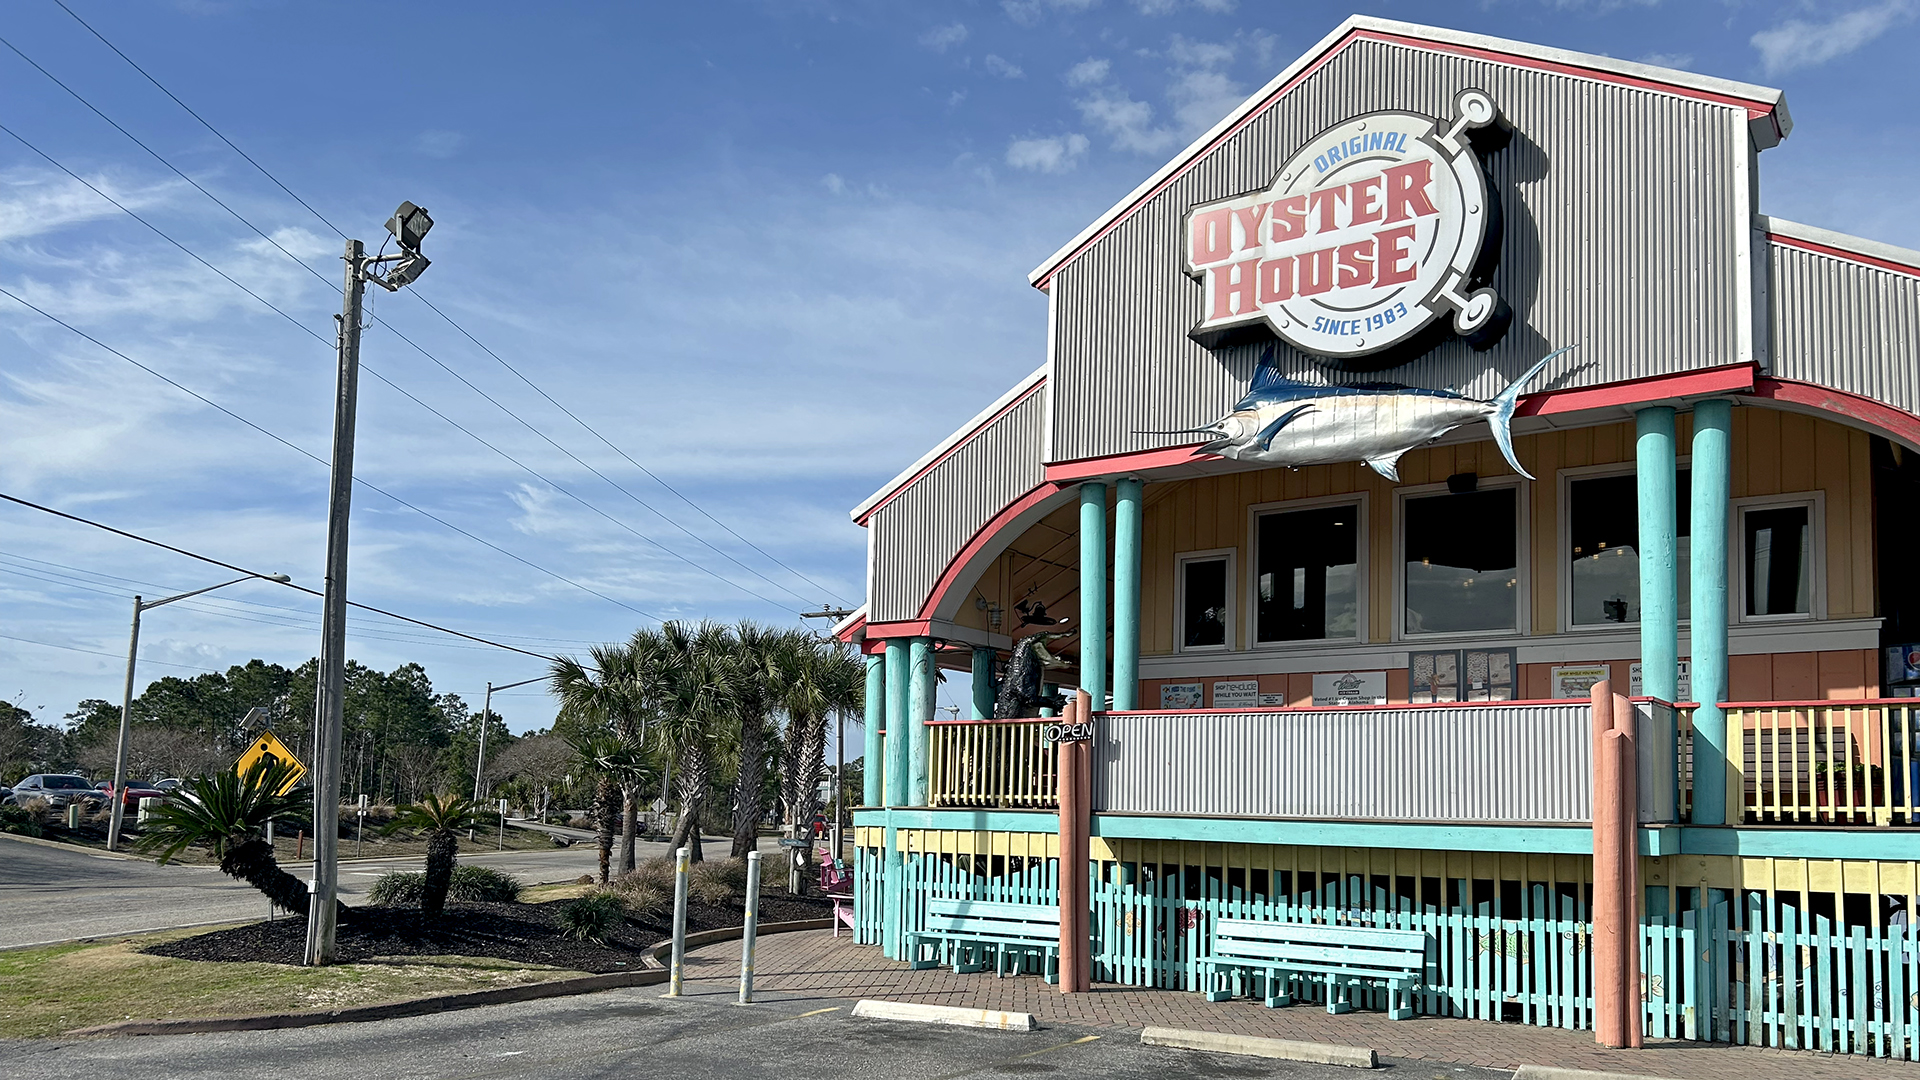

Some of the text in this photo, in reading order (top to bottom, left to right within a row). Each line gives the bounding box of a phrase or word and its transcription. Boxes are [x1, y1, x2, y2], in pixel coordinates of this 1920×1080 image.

[1313, 131, 1408, 174] ORIGINAL
[1191, 158, 1440, 266] OYSTER
[1209, 224, 1418, 321] HOUSE
[1312, 302, 1409, 336] SINCE 1983
[1046, 722, 1093, 741] OPEN
